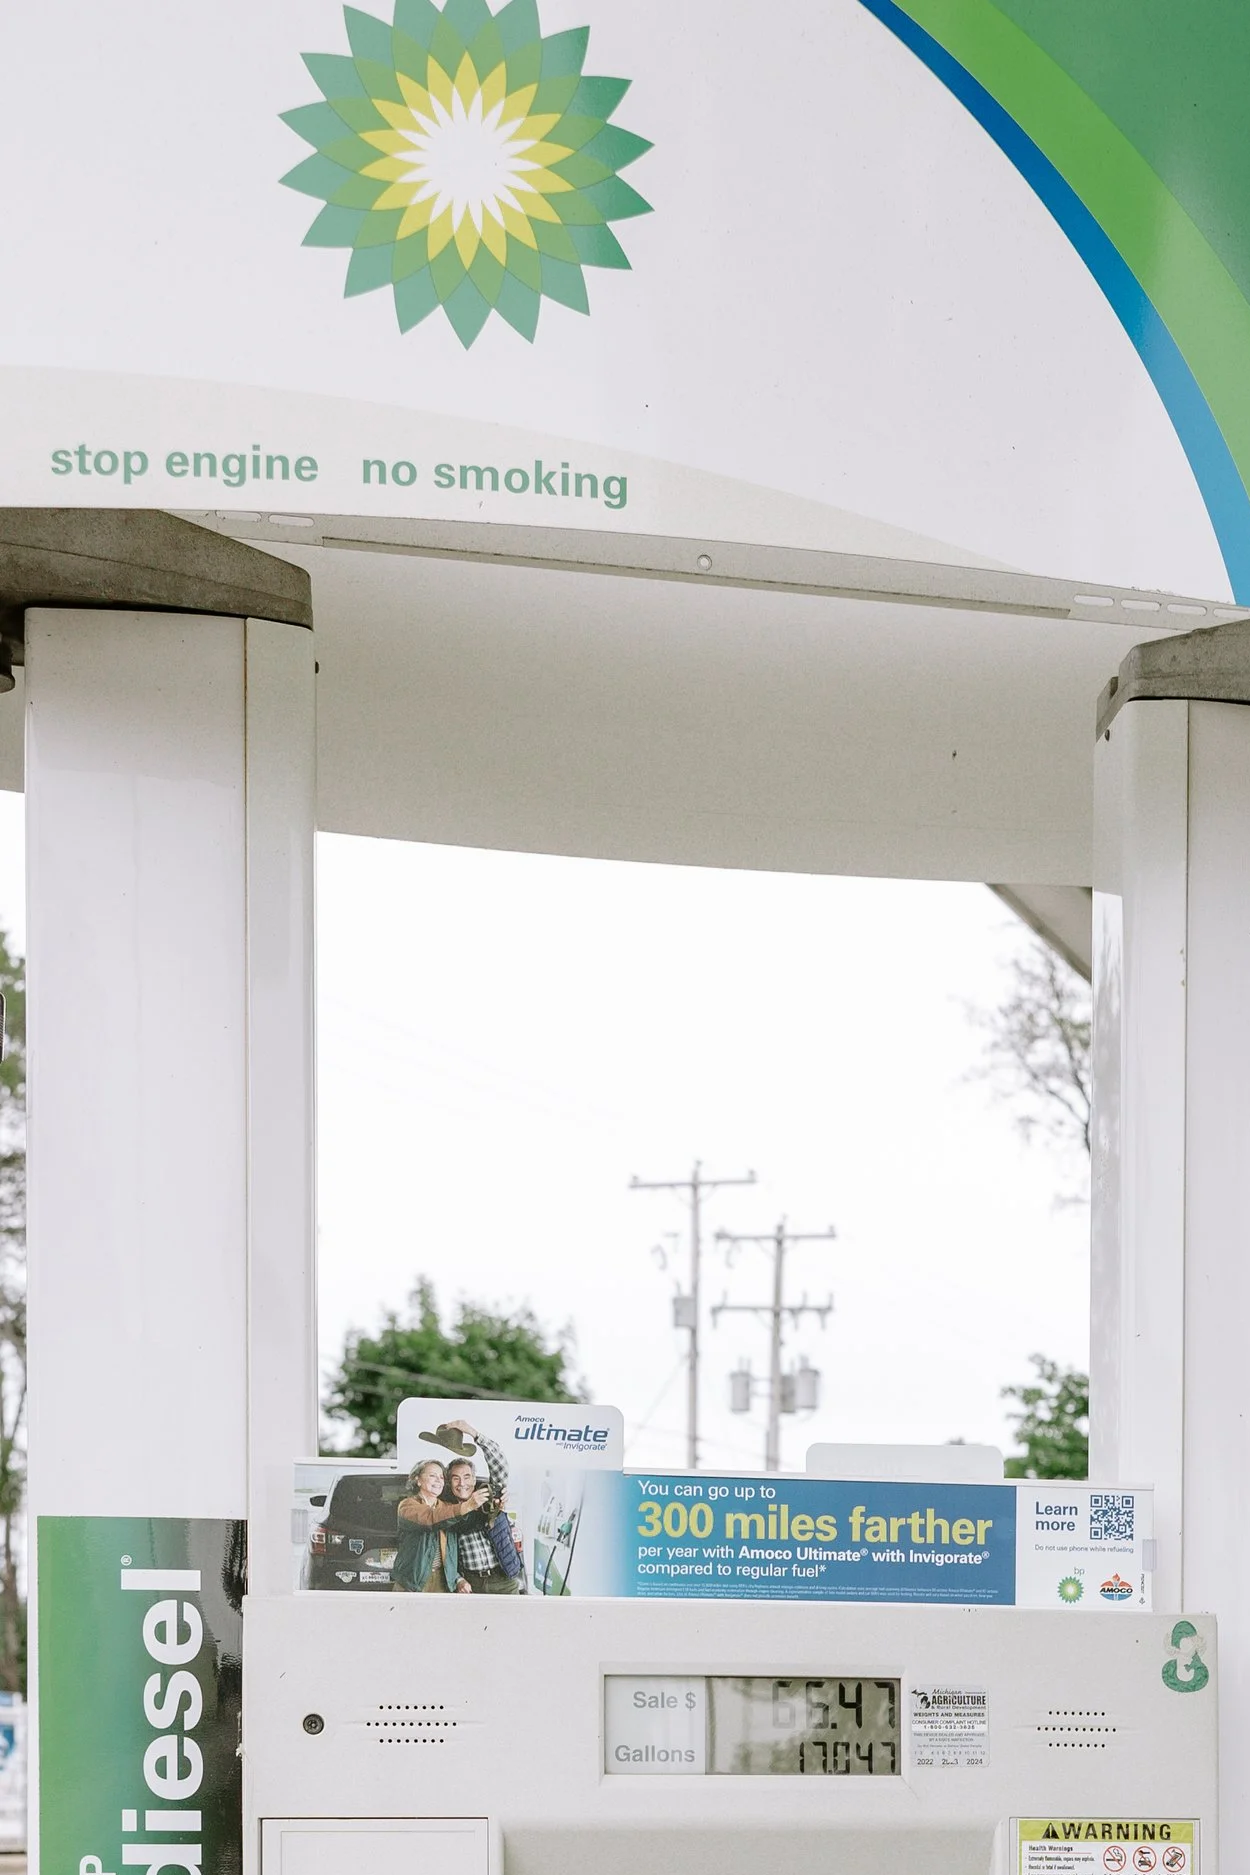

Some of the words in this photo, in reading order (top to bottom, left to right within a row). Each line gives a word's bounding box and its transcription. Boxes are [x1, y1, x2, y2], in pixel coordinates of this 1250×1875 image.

[51, 444, 149, 484] stop
[165, 445, 319, 488] engine
[362, 458, 417, 487] no
[434, 460, 628, 508] smoking
[638, 1480, 669, 1496] You
[674, 1485, 702, 1496] can
[708, 1486, 729, 1500] go
[735, 1486, 755, 1500] up
[760, 1485, 776, 1498] to
[1035, 1501, 1077, 1516] Learn
[638, 1501, 714, 1538] 300
[725, 1503, 838, 1542] miles
[849, 1506, 992, 1545] farther
[1036, 1521, 1075, 1531] more
[638, 1547, 662, 1558] per
[667, 1547, 698, 1559] year
[703, 1545, 734, 1558] with
[739, 1546, 792, 1560] Amoco
[872, 1550, 905, 1562] with
[1107, 1546, 1134, 1554] refueling
[638, 1562, 712, 1575] compared
[717, 1564, 732, 1575] to
[737, 1564, 787, 1579] regular
[1074, 1567, 1085, 1576] bp
[633, 1692, 678, 1709] Sale
[685, 1692, 696, 1710] $
[615, 1744, 695, 1762] Gallons
[1061, 1824, 1171, 1840] WARNING
